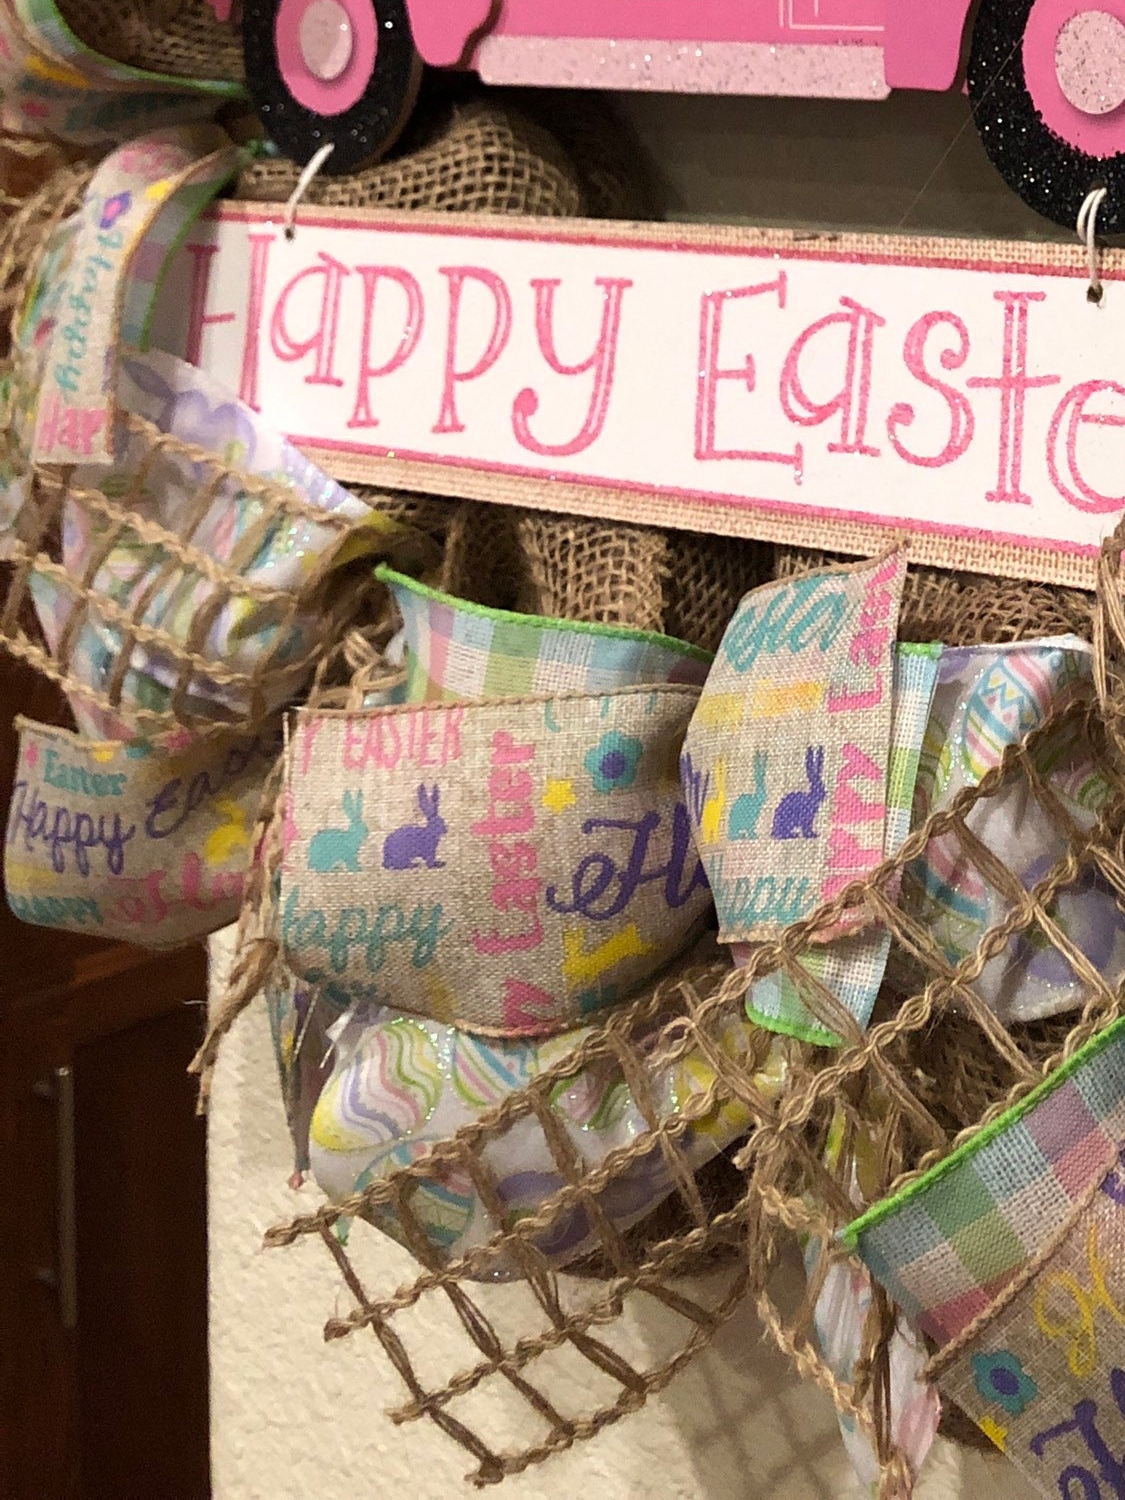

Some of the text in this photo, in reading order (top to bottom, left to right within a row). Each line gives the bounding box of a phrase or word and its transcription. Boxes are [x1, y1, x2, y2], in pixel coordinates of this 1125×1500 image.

[185, 233, 634, 459] Happy
[7, 778, 137, 878] Happy
[469, 730, 544, 956] Easter
